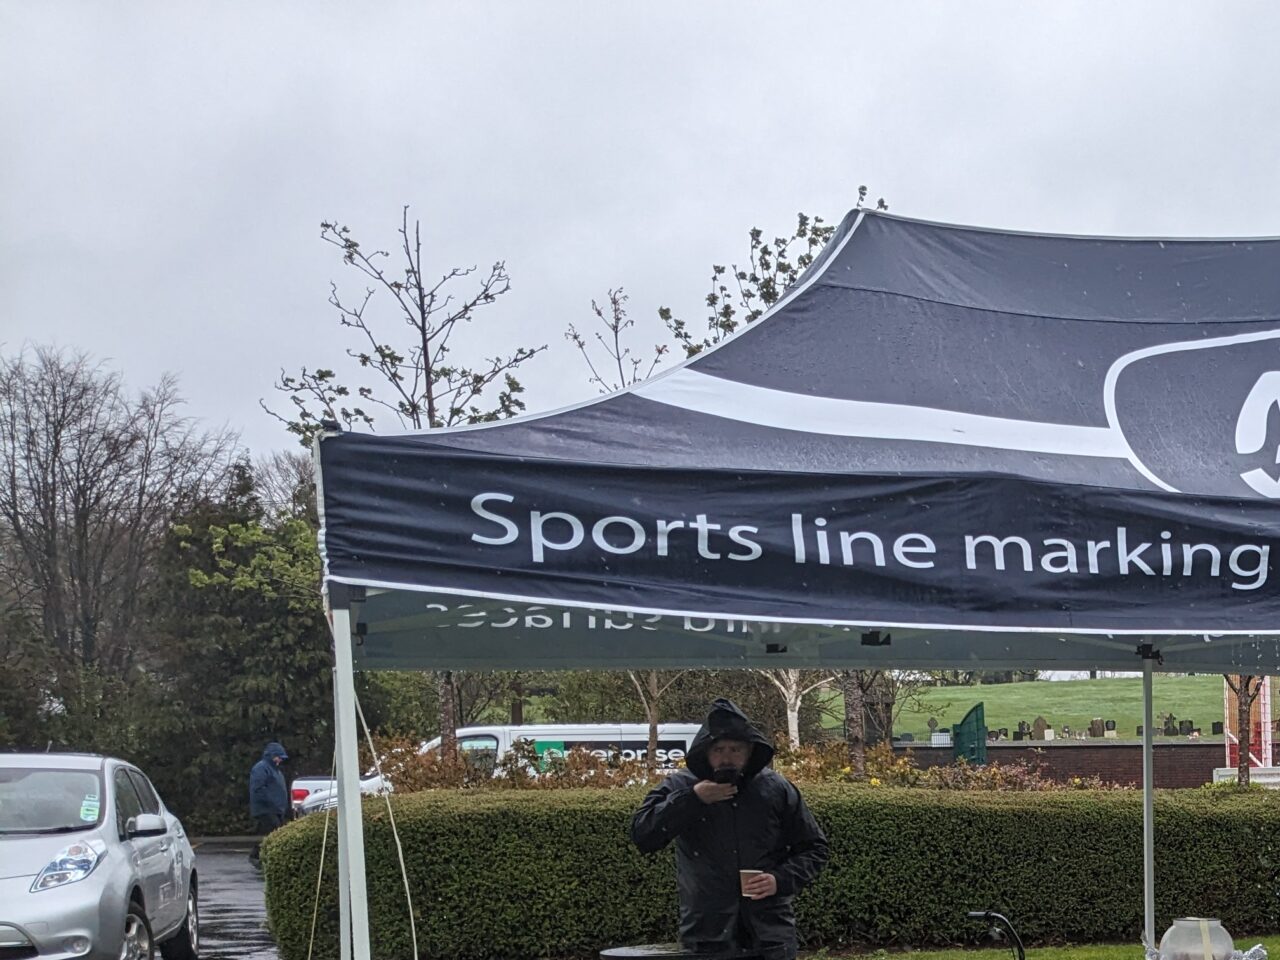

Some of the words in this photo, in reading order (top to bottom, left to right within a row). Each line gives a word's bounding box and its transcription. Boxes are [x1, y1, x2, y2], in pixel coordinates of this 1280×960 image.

[470, 492, 764, 563] Sports
[791, 512, 937, 570] line
[964, 526, 1271, 590] marking
